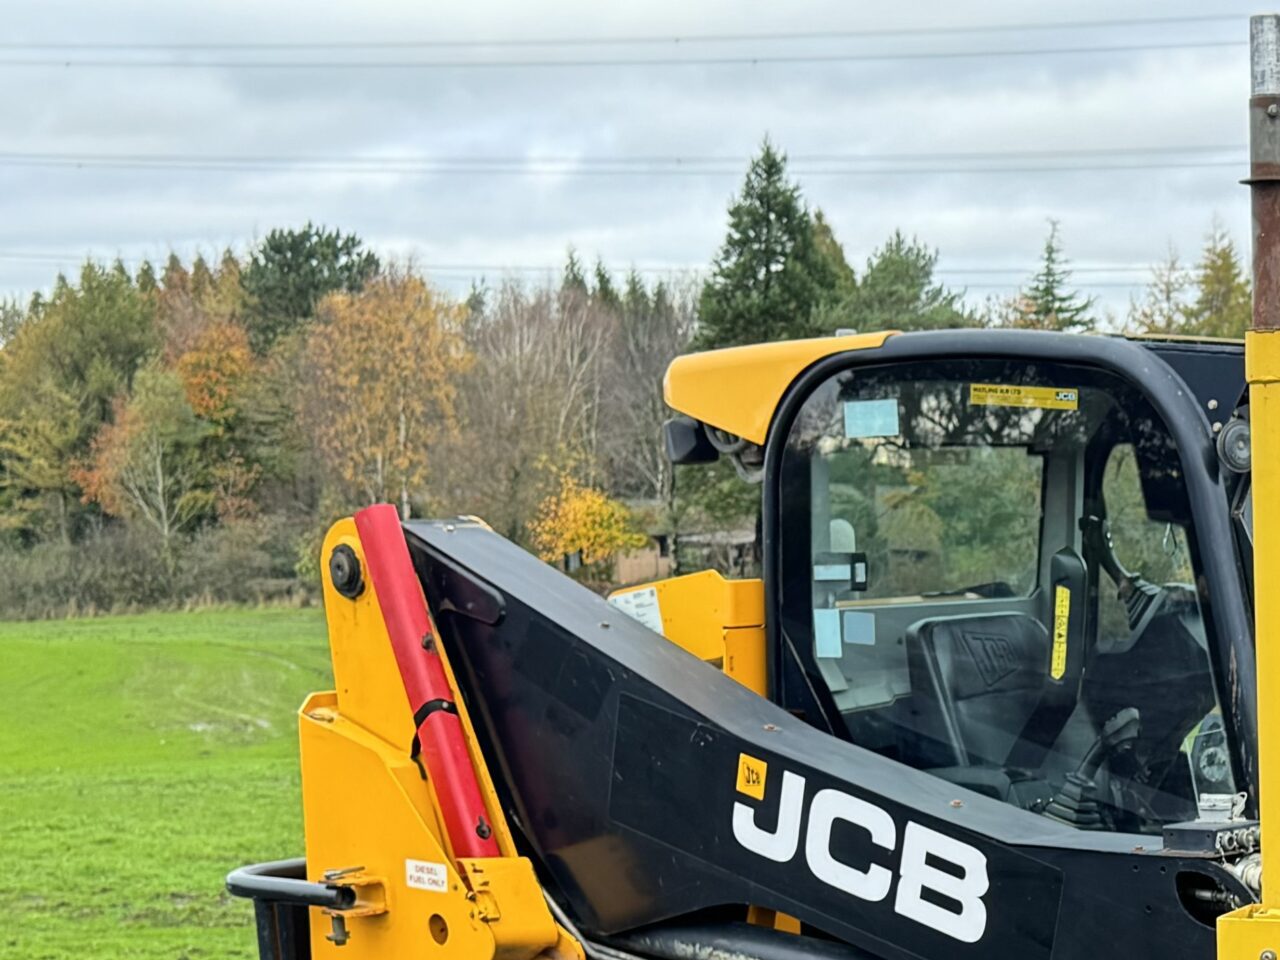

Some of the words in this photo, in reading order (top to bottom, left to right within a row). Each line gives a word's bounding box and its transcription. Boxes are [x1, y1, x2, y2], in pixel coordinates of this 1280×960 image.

[1055, 391, 1076, 401] JCB
[732, 769, 989, 943] JCB
[415, 864, 438, 876] DIESEL
[409, 874, 425, 885] FUEL
[427, 877, 445, 888] ONLY
